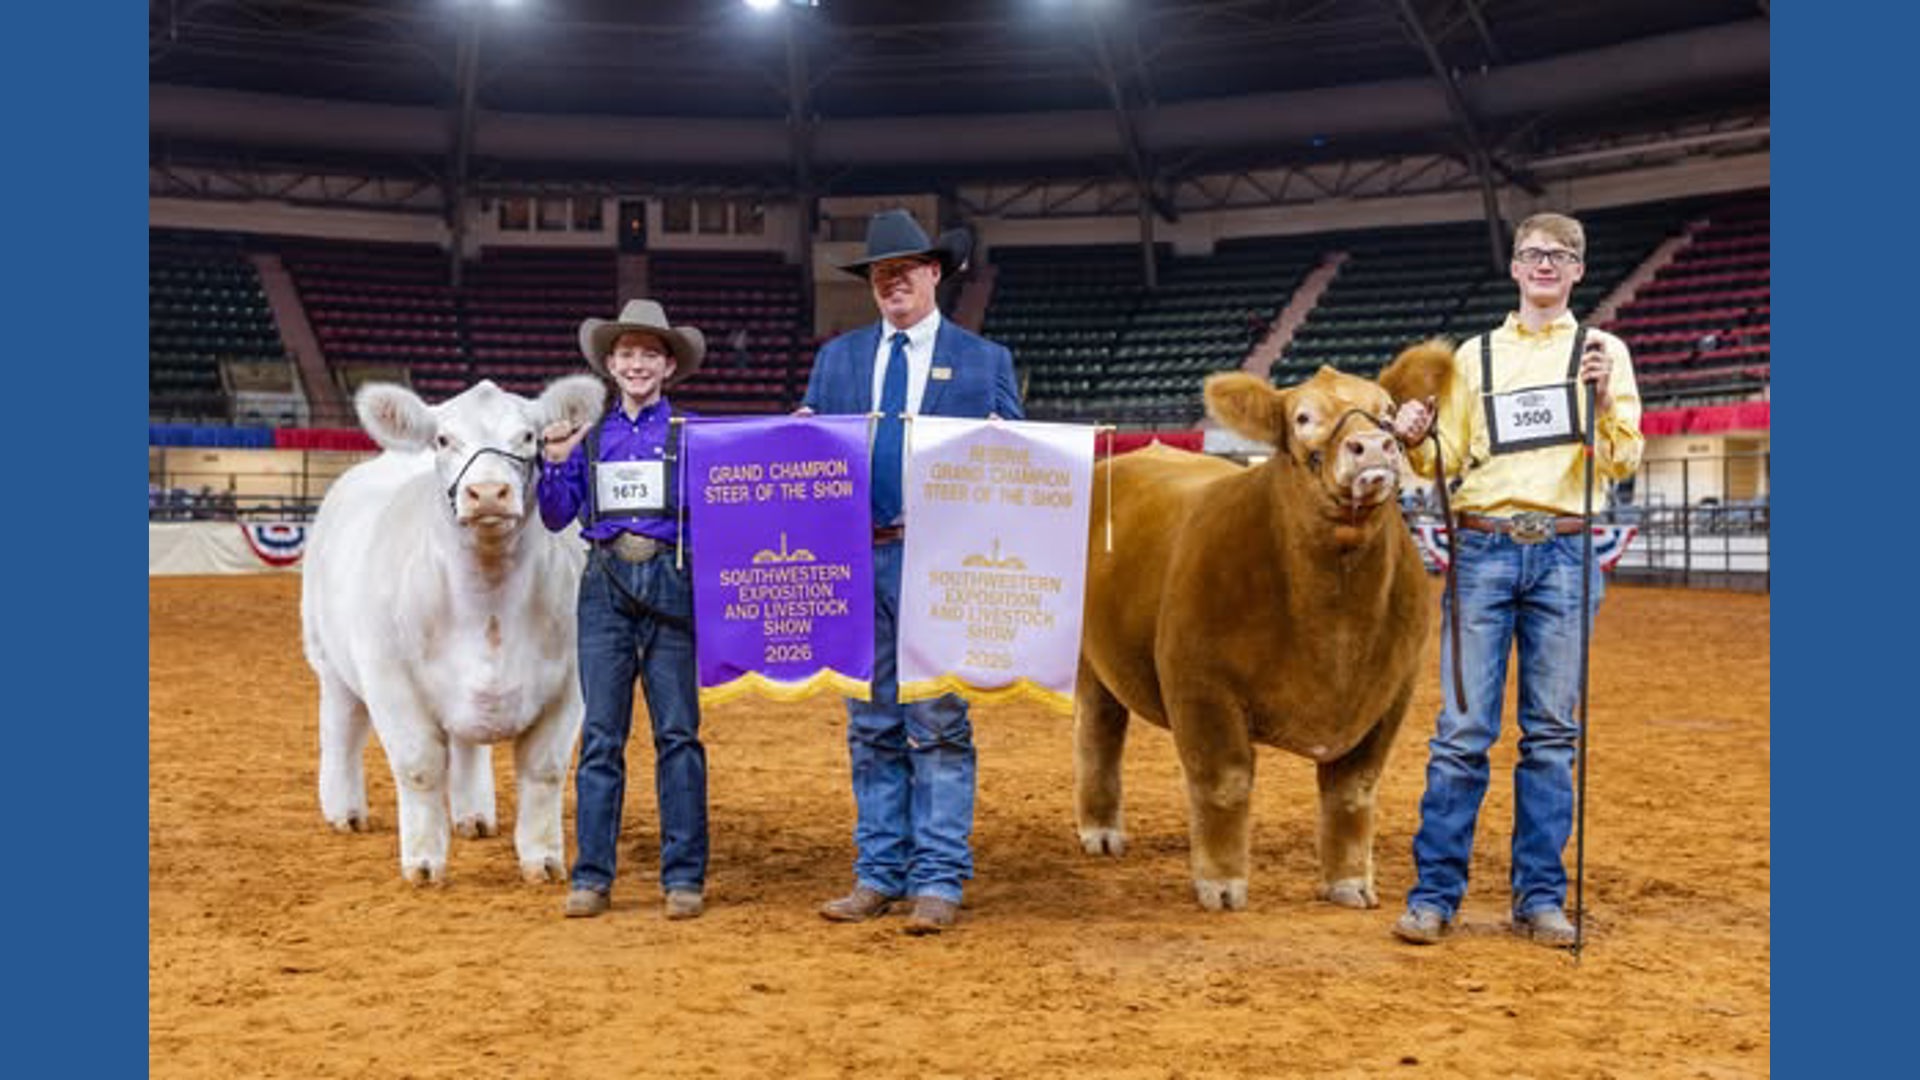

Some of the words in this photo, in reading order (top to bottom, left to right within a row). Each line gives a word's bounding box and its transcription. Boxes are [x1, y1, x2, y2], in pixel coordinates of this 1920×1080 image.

[1513, 408, 1553, 427] 3500
[709, 464, 763, 484] GRAND
[769, 460, 848, 480] CHAMPION
[930, 463, 984, 482] GRAND
[990, 466, 1072, 486] CHAMPION
[613, 483, 648, 500] 1673
[705, 485, 749, 503] STEER
[755, 483, 773, 501] OF
[780, 482, 807, 499] THE
[813, 480, 853, 498] SHOW
[924, 483, 968, 501] STEER
[973, 485, 990, 503] OF
[1000, 487, 1024, 504] THE
[1031, 489, 1073, 508] SHOW
[720, 564, 851, 587] SOUTHWESTERN
[929, 571, 1061, 593] SOUTHWESTERN
[739, 583, 834, 603] EXPOSITION
[946, 588, 1041, 606] EXPOSITION
[725, 603, 759, 621] AND
[764, 599, 849, 620] LIVESTOCK
[929, 603, 962, 621] AND
[967, 606, 1056, 628] LIVESTOCK
[764, 618, 812, 637] SHOW
[967, 624, 1015, 641] SHOW
[764, 645, 812, 663] 2026
